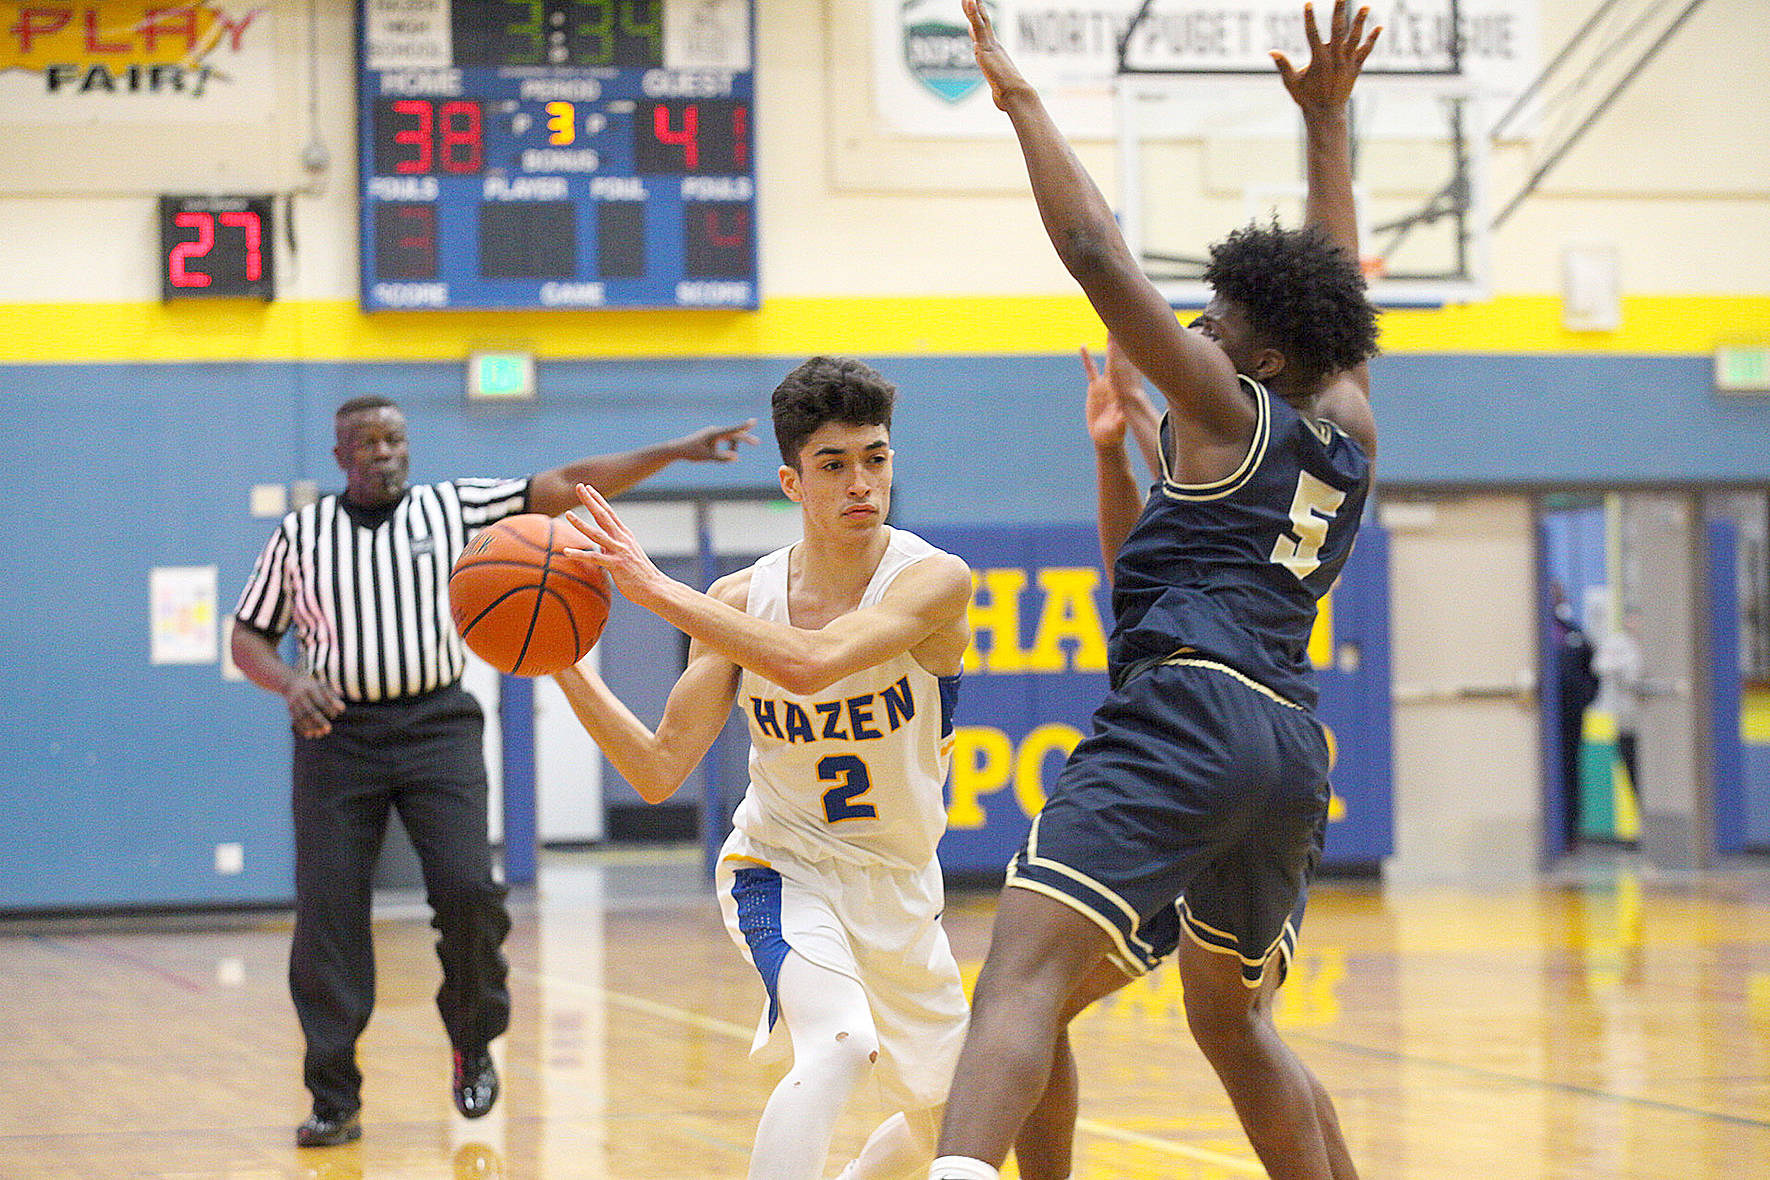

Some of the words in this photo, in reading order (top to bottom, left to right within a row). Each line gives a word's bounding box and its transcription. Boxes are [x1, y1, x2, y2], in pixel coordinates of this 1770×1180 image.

[9, 7, 268, 54] PLAY
[642, 69, 733, 98] GUEST
[392, 100, 483, 174] 38
[545, 101, 576, 146] 3
[653, 104, 748, 171] 41
[368, 176, 440, 201] FOULS
[482, 176, 569, 202] PLAYER
[589, 176, 649, 201] FOUL
[681, 176, 753, 201] FOULS
[168, 211, 263, 289] 27
[371, 282, 450, 307] SCORE
[675, 281, 752, 306] SCORE
[1269, 468, 1347, 581] 5
[750, 674, 916, 745] HAZEN
[815, 752, 880, 825] 2
